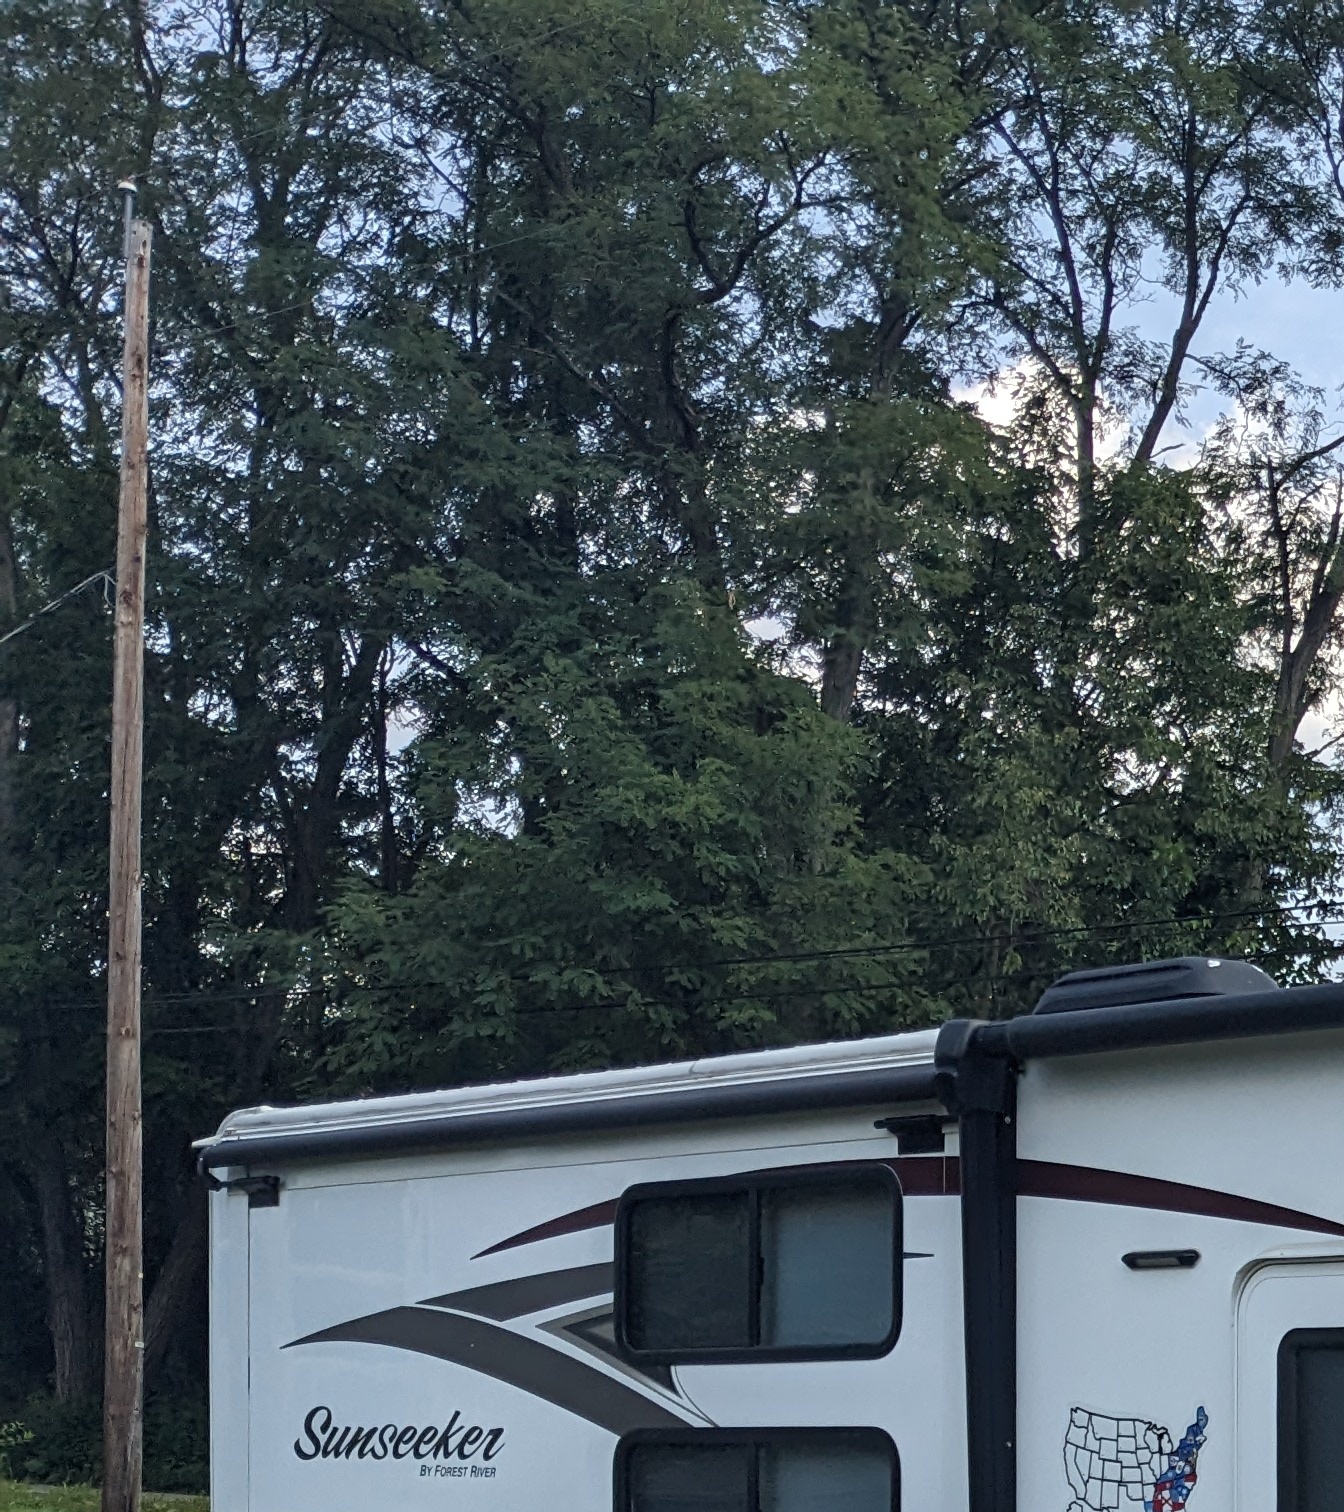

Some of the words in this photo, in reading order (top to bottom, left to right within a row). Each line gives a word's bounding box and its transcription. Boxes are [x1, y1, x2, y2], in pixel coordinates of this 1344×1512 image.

[294, 1406, 505, 1461] Sunseeker
[420, 1465, 433, 1477] BY
[434, 1465, 468, 1478] FOREST
[470, 1465, 497, 1478] RIVER
